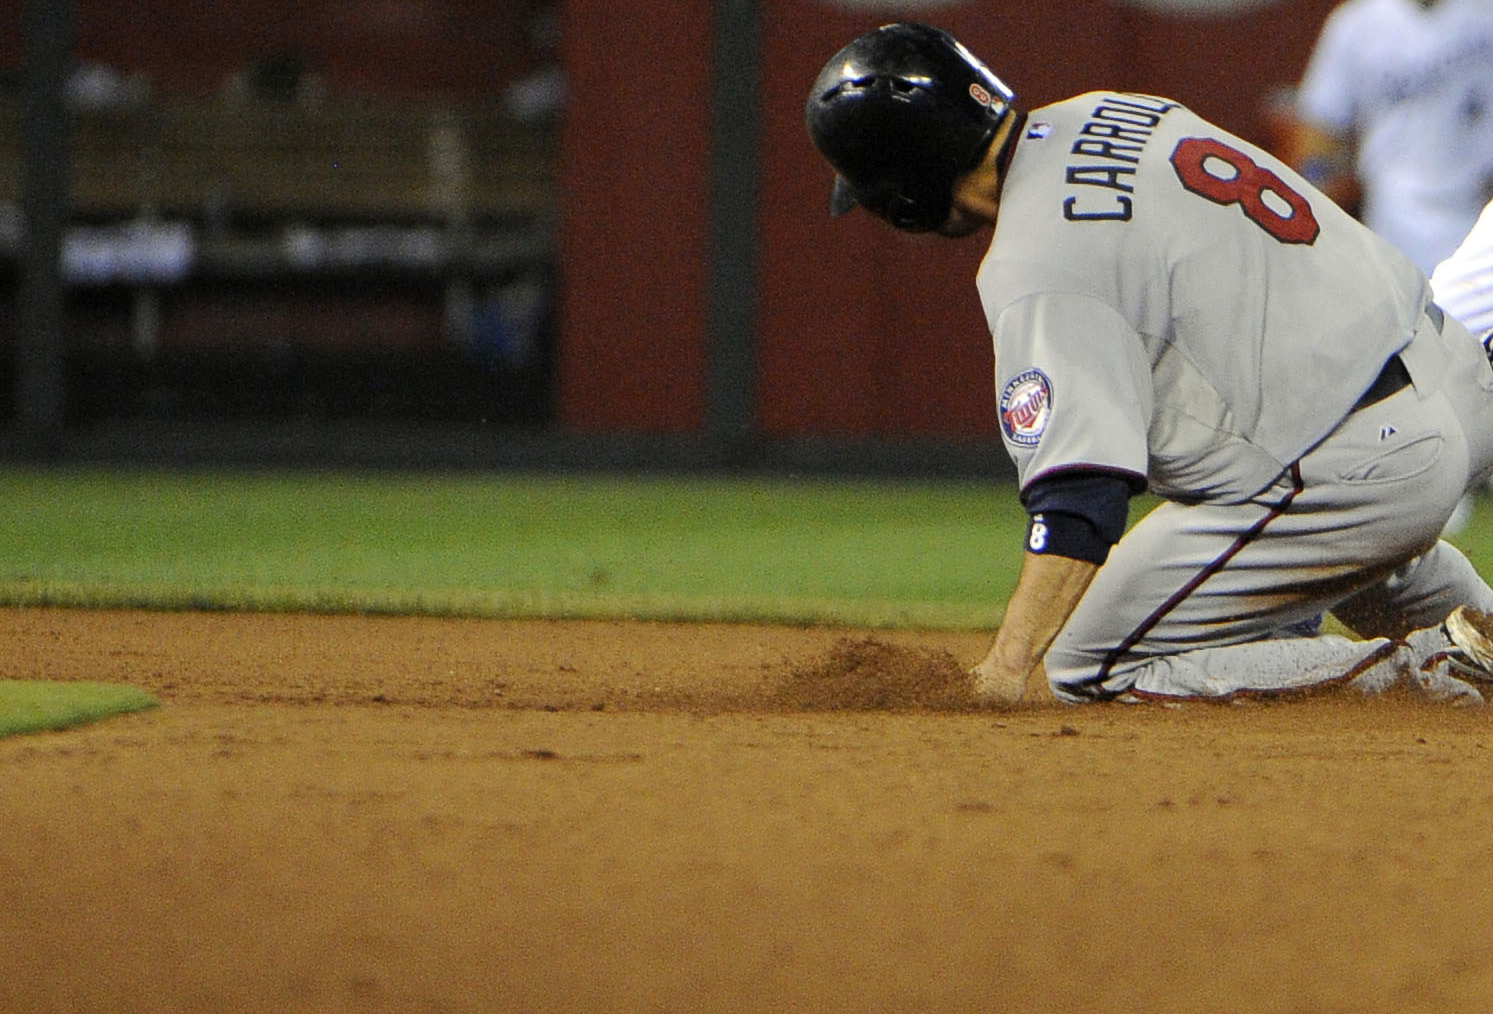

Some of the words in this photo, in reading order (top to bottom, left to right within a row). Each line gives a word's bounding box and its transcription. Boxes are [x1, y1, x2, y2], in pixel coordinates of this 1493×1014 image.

[968, 83, 991, 107] 8
[1168, 136, 1321, 247] 8
[1029, 522, 1048, 551] 8
